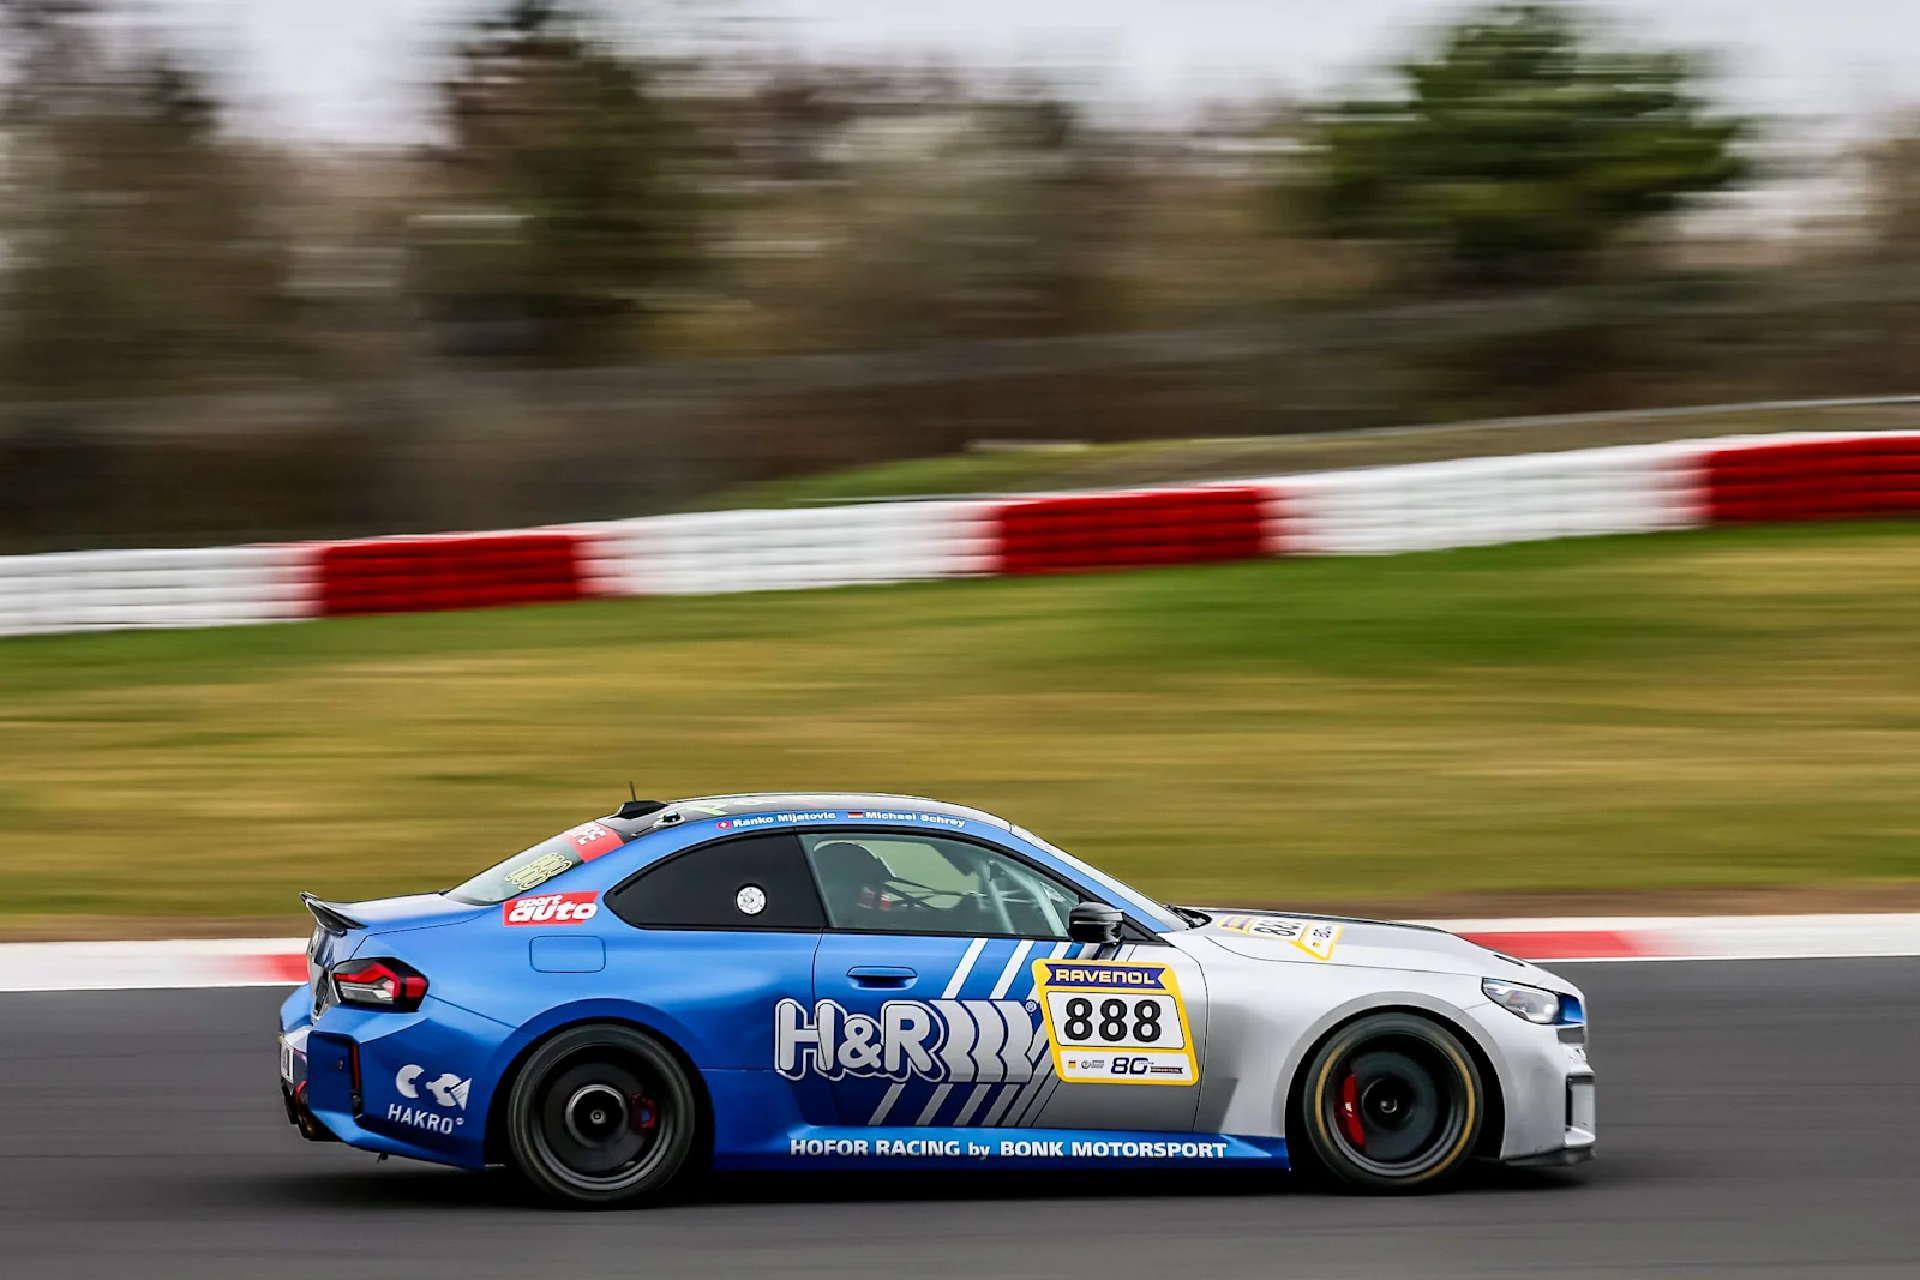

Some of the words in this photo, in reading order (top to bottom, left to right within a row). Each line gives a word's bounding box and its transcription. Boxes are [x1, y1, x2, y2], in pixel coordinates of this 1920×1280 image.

[865, 811, 917, 821] Michael
[920, 813, 966, 828] Schrey
[508, 902, 598, 922] auto
[1055, 969, 1155, 985] RAVENOL
[1064, 997, 1162, 1043] 888
[775, 998, 945, 1082] H&R
[387, 1103, 454, 1135] HAKRO
[790, 1139, 869, 1156] HOFOR
[875, 1140, 961, 1157] RACING
[967, 1142, 991, 1161] by
[999, 1140, 1064, 1157] BONK
[1071, 1141, 1228, 1158] MOTORSPORT
